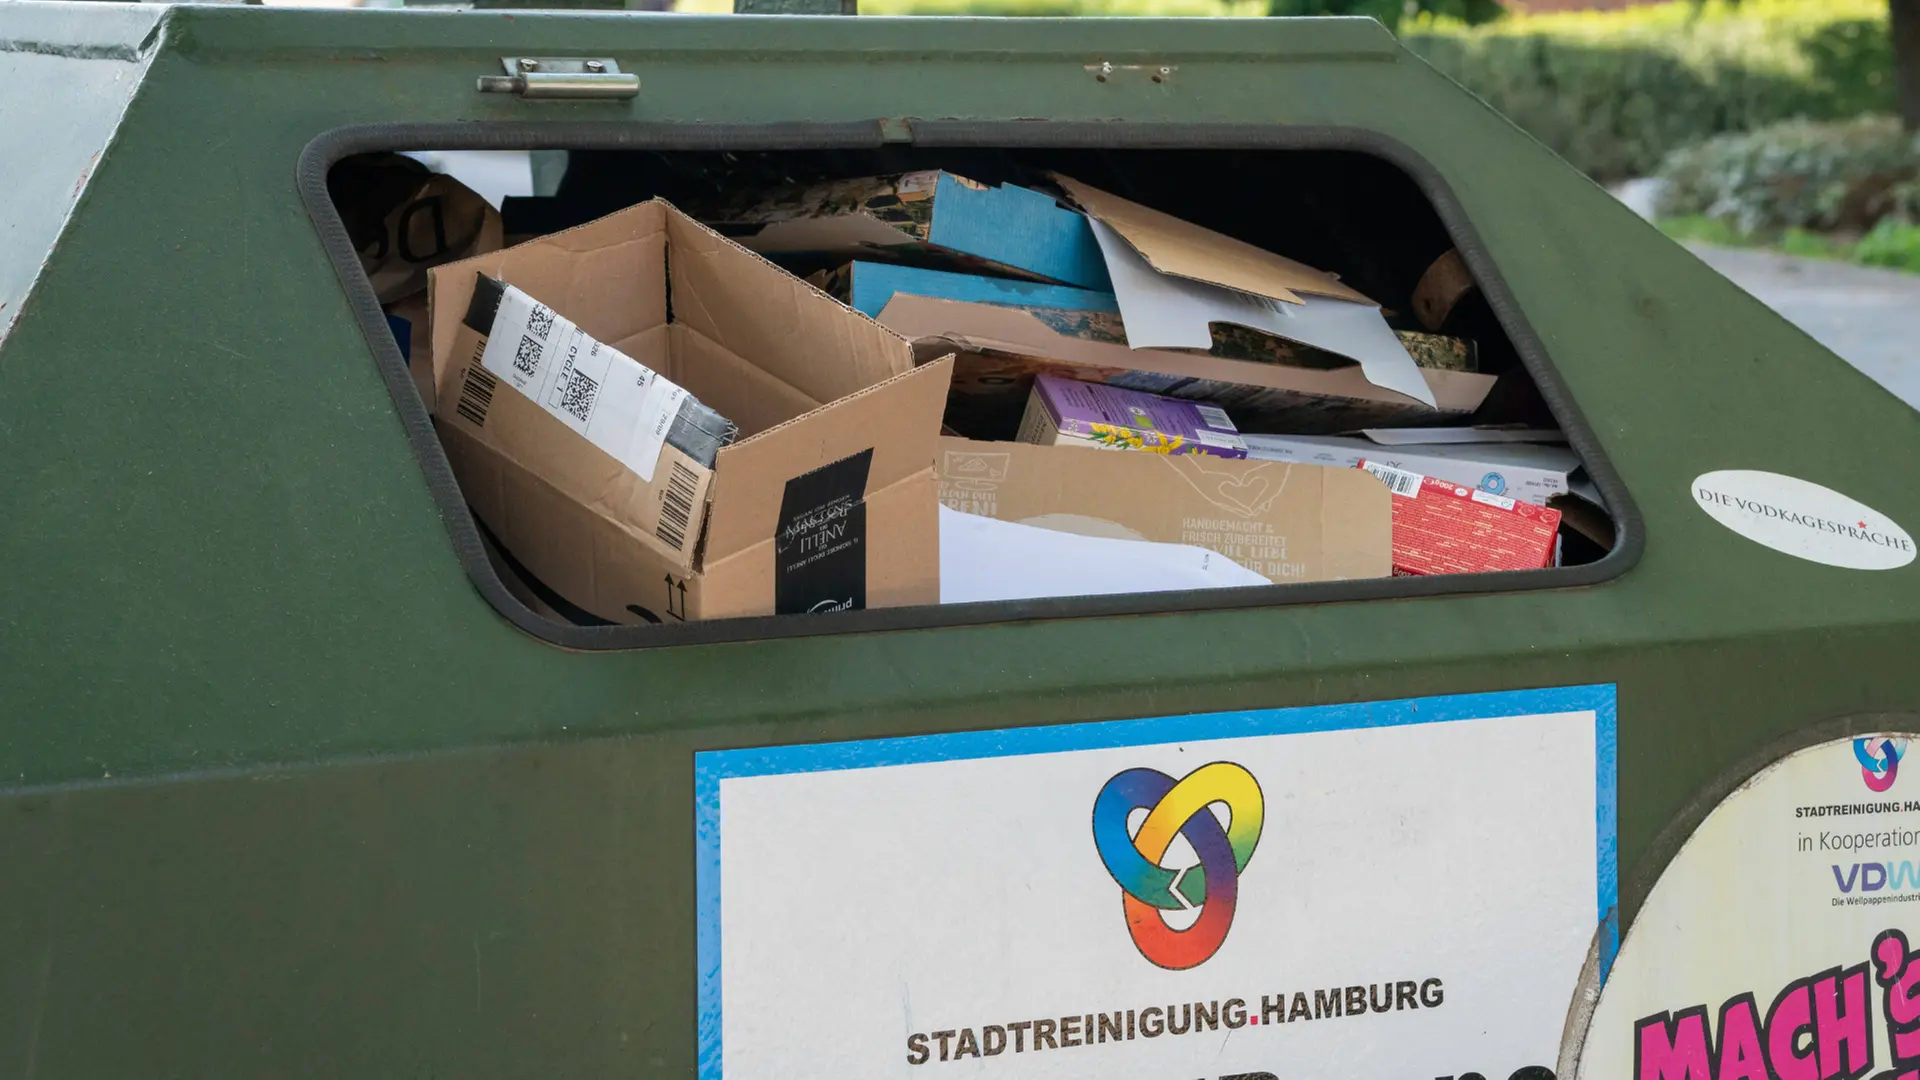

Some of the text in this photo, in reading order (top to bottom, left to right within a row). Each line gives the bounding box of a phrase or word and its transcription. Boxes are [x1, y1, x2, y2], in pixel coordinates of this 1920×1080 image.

[560, 345, 578, 381] CYCLE
[1699, 488, 1731, 507] DIE
[1182, 518, 1264, 533] HANDGEMACHT
[800, 519, 848, 554] ANELLI
[1182, 530, 1221, 543] FRISCH
[1223, 532, 1287, 547] ZUBEREITET
[1268, 562, 1306, 577] DICH!
[1798, 832, 1812, 852] in
[1832, 898, 1845, 906] Die
[906, 977, 1444, 1065] STADTREINIGUNG.HAMBURG
